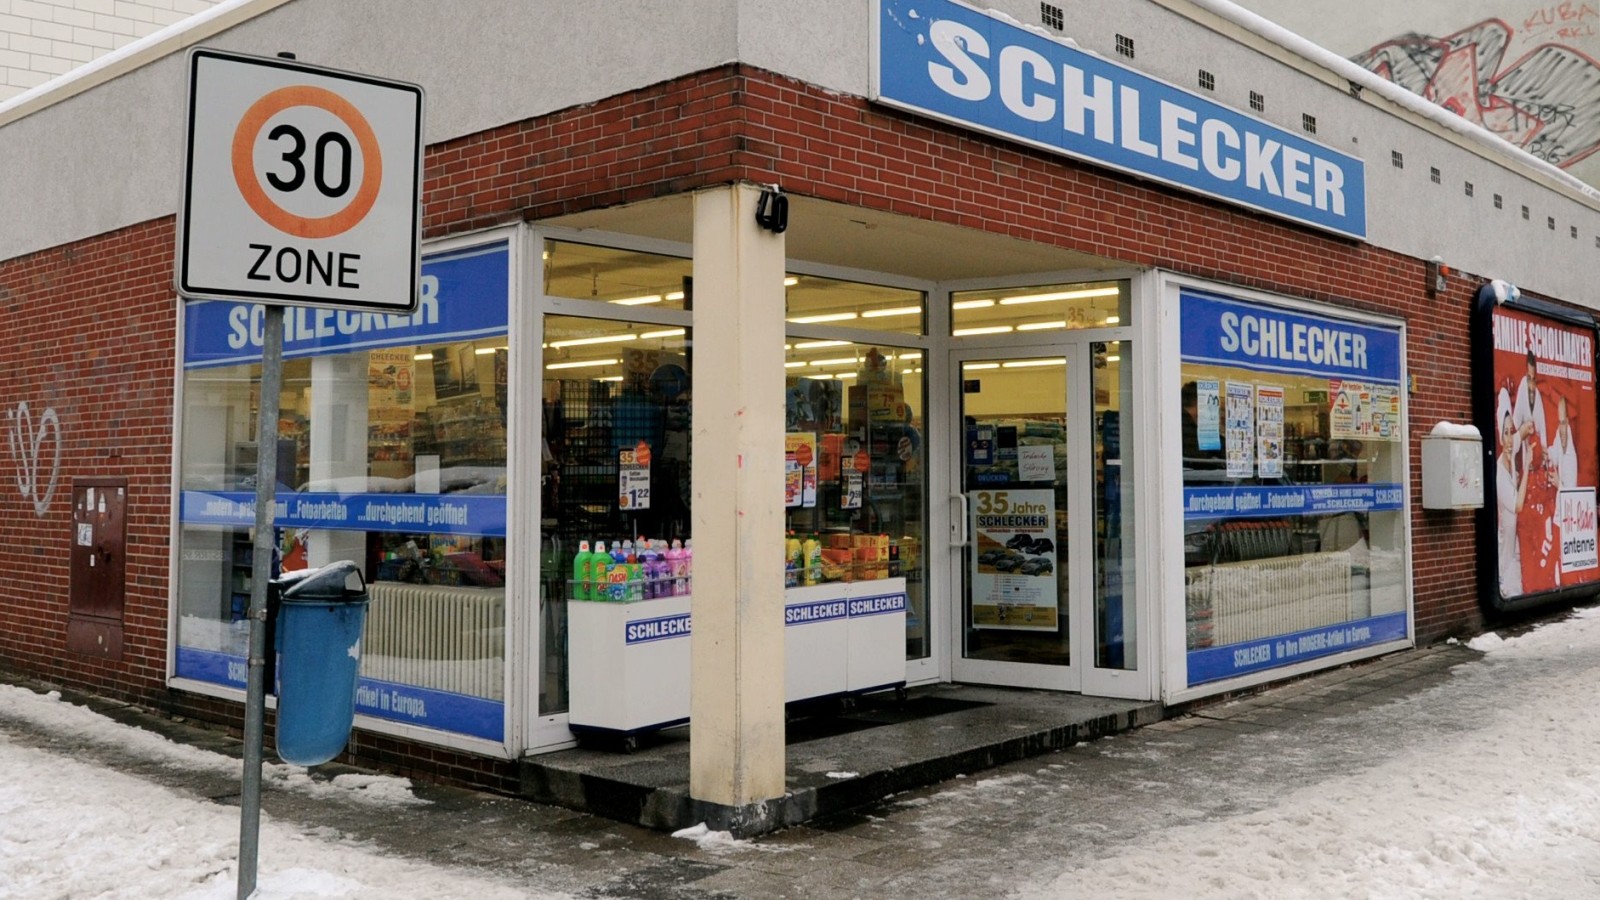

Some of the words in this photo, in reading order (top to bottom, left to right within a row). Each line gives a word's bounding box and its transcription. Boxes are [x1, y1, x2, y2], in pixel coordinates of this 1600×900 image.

[928, 19, 1346, 216] SCHLECKER
[265, 124, 352, 198] 30
[247, 243, 361, 289] ZONE
[228, 275, 439, 349] SCLECR
[1220, 311, 1368, 369] SCHLECKER
[427, 503, 467, 526] geöffnet
[976, 492, 1008, 514] 35
[1011, 502, 1046, 514] Jahre
[979, 515, 1046, 527] SCHLECKER
[1563, 537, 1595, 555] antenne
[628, 618, 691, 640] SCHLECKE
[786, 602, 846, 622] SCHLECKER
[850, 596, 904, 614] SCHLECKER
[1233, 643, 1271, 668] SCHLECKER
[356, 686, 379, 709] rtikel
[380, 689, 389, 710] in
[391, 689, 427, 718] Europa.
